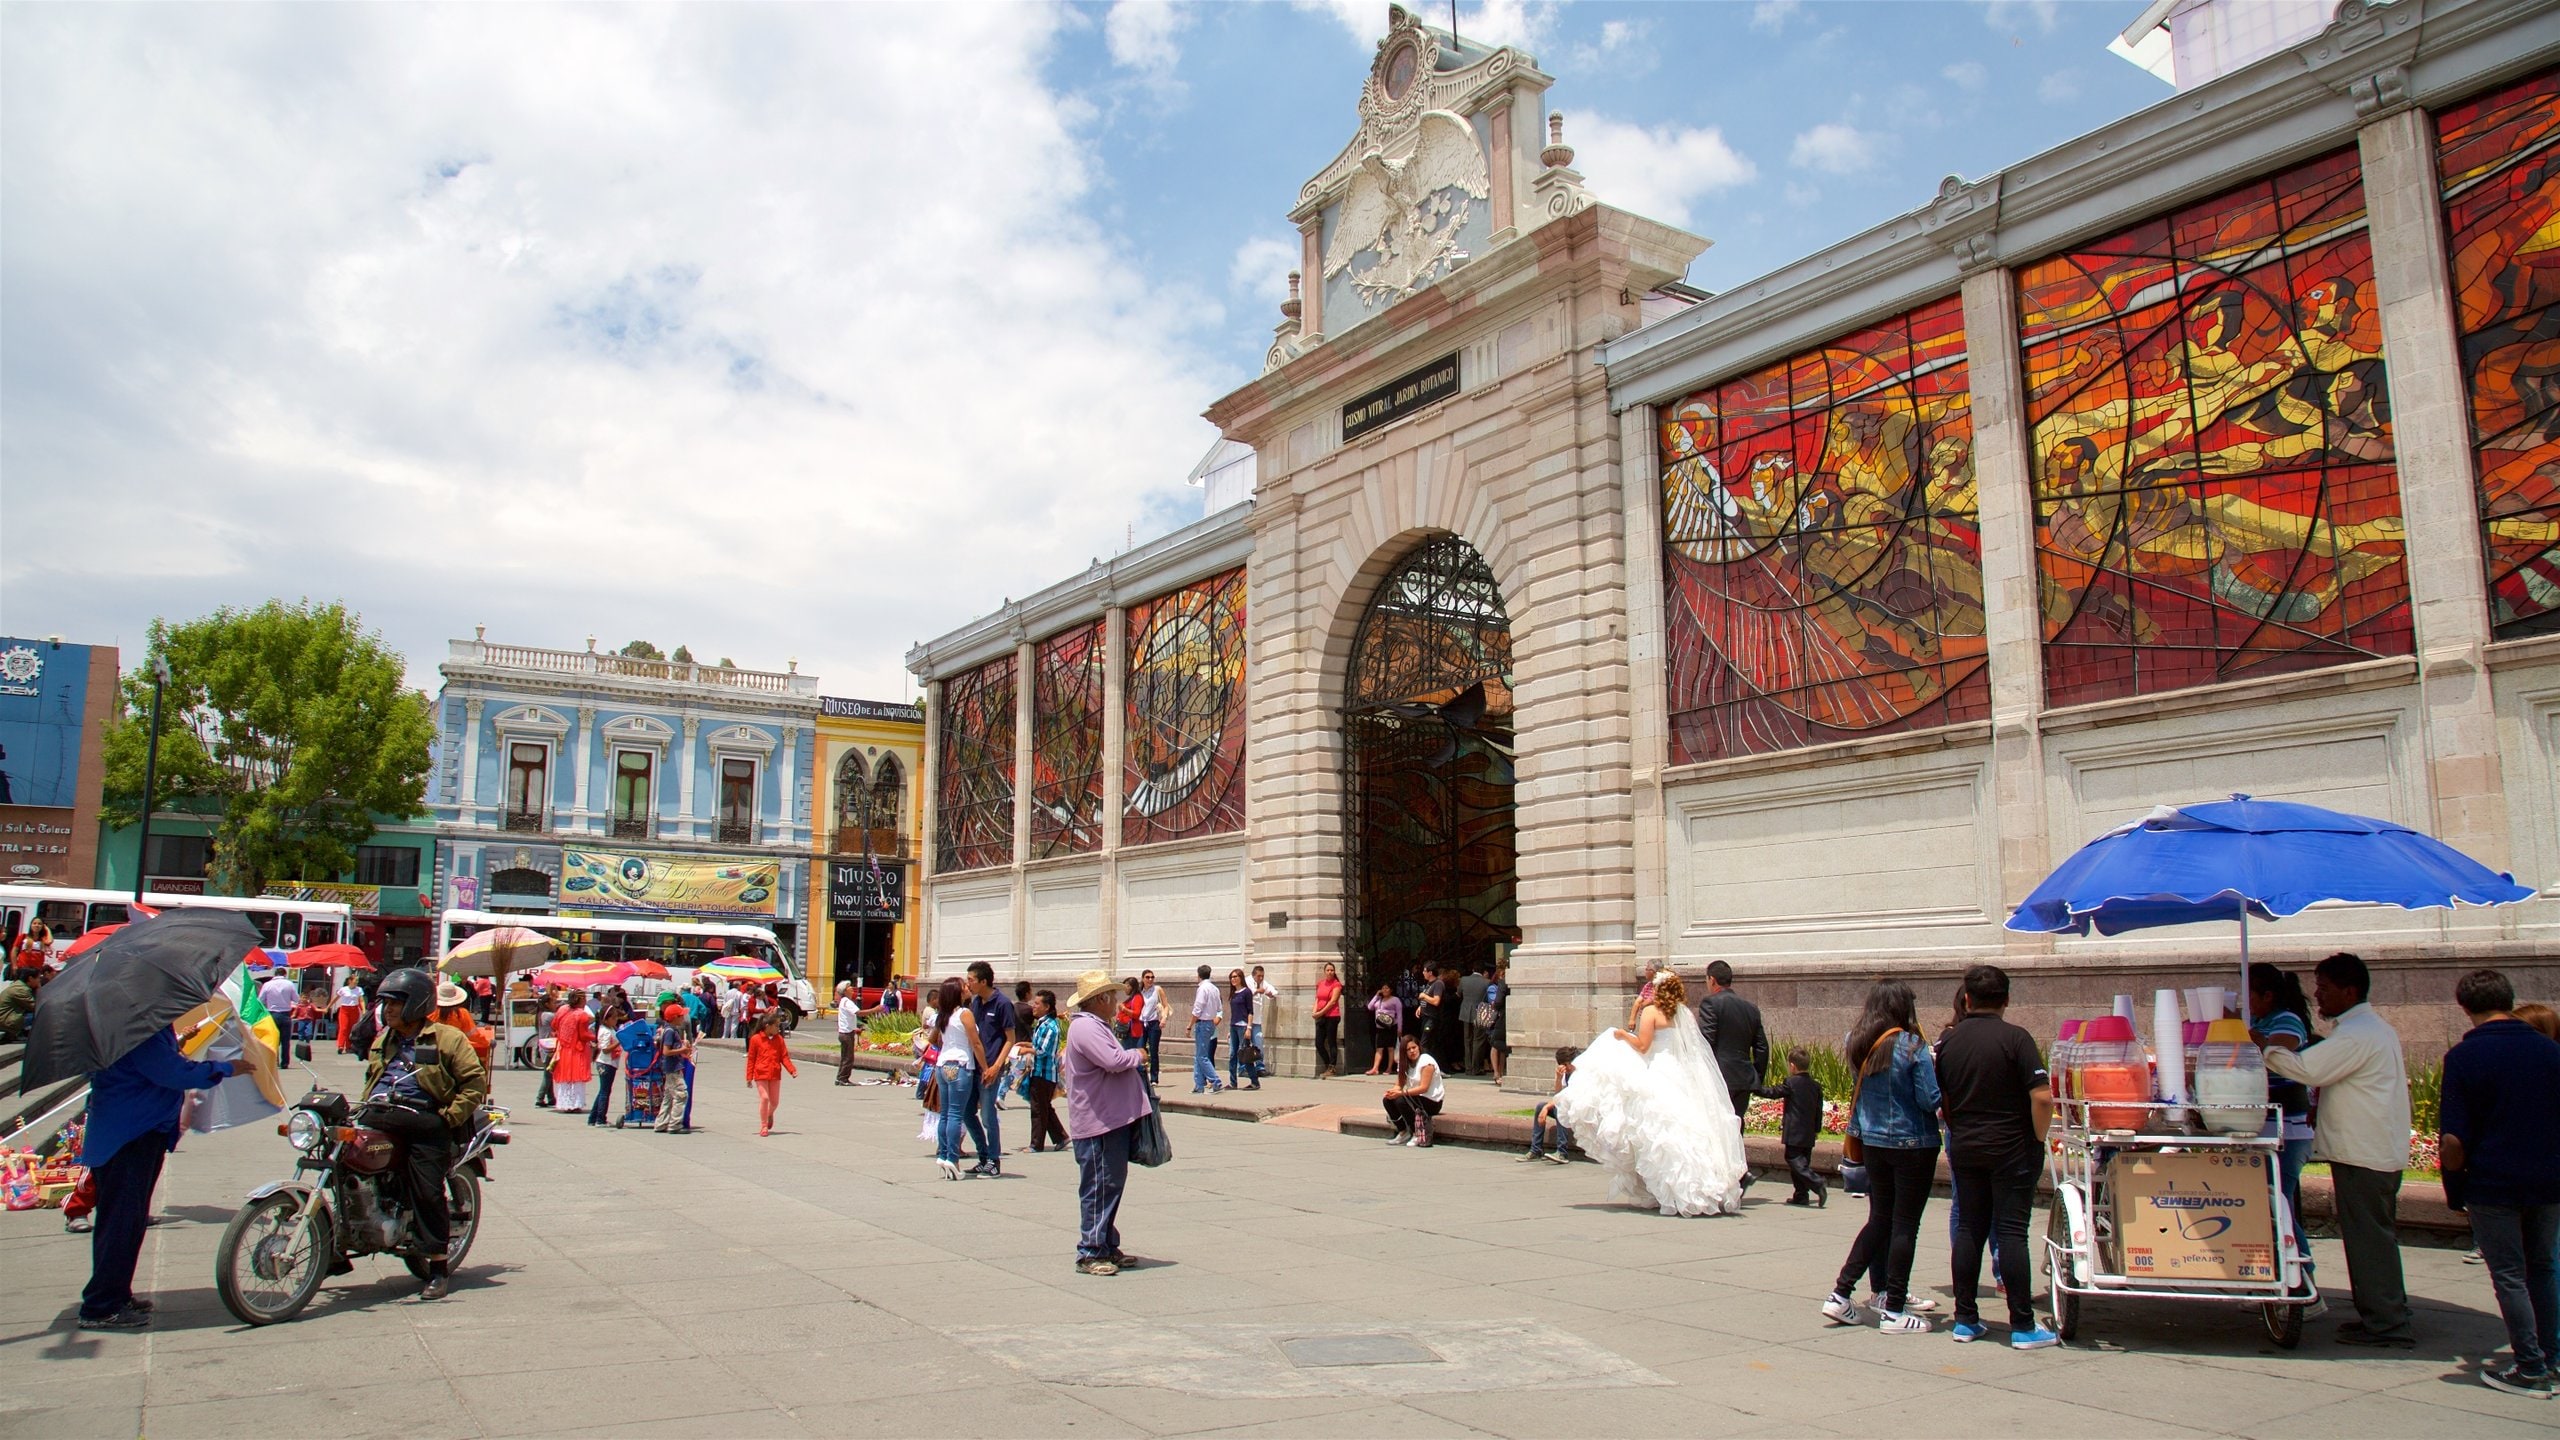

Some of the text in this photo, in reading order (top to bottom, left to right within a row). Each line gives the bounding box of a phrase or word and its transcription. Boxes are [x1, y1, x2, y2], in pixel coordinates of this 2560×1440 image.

[1346, 367, 1453, 428] COSMO VITRAL JARDIN BOTANICO
[825, 697, 861, 716] MUSEO
[861, 706, 871, 715] DE
[873, 707, 883, 716] LA
[5, 823, 22, 833] Sol
[25, 824, 35, 833] de
[38, 823, 71, 834] Toluca
[578, 896, 621, 905] CALDOS
[833, 891, 900, 909] INQUSICÓN
[367, 1143, 394, 1152] HONDA
[2150, 1196, 2245, 1209] CONVERMEX
[2127, 1247, 2153, 1255] ENVASES
[2135, 1256, 2154, 1266] 300
[2182, 1253, 2225, 1265] Carvajal
[2238, 1265, 2271, 1276] No. 732
